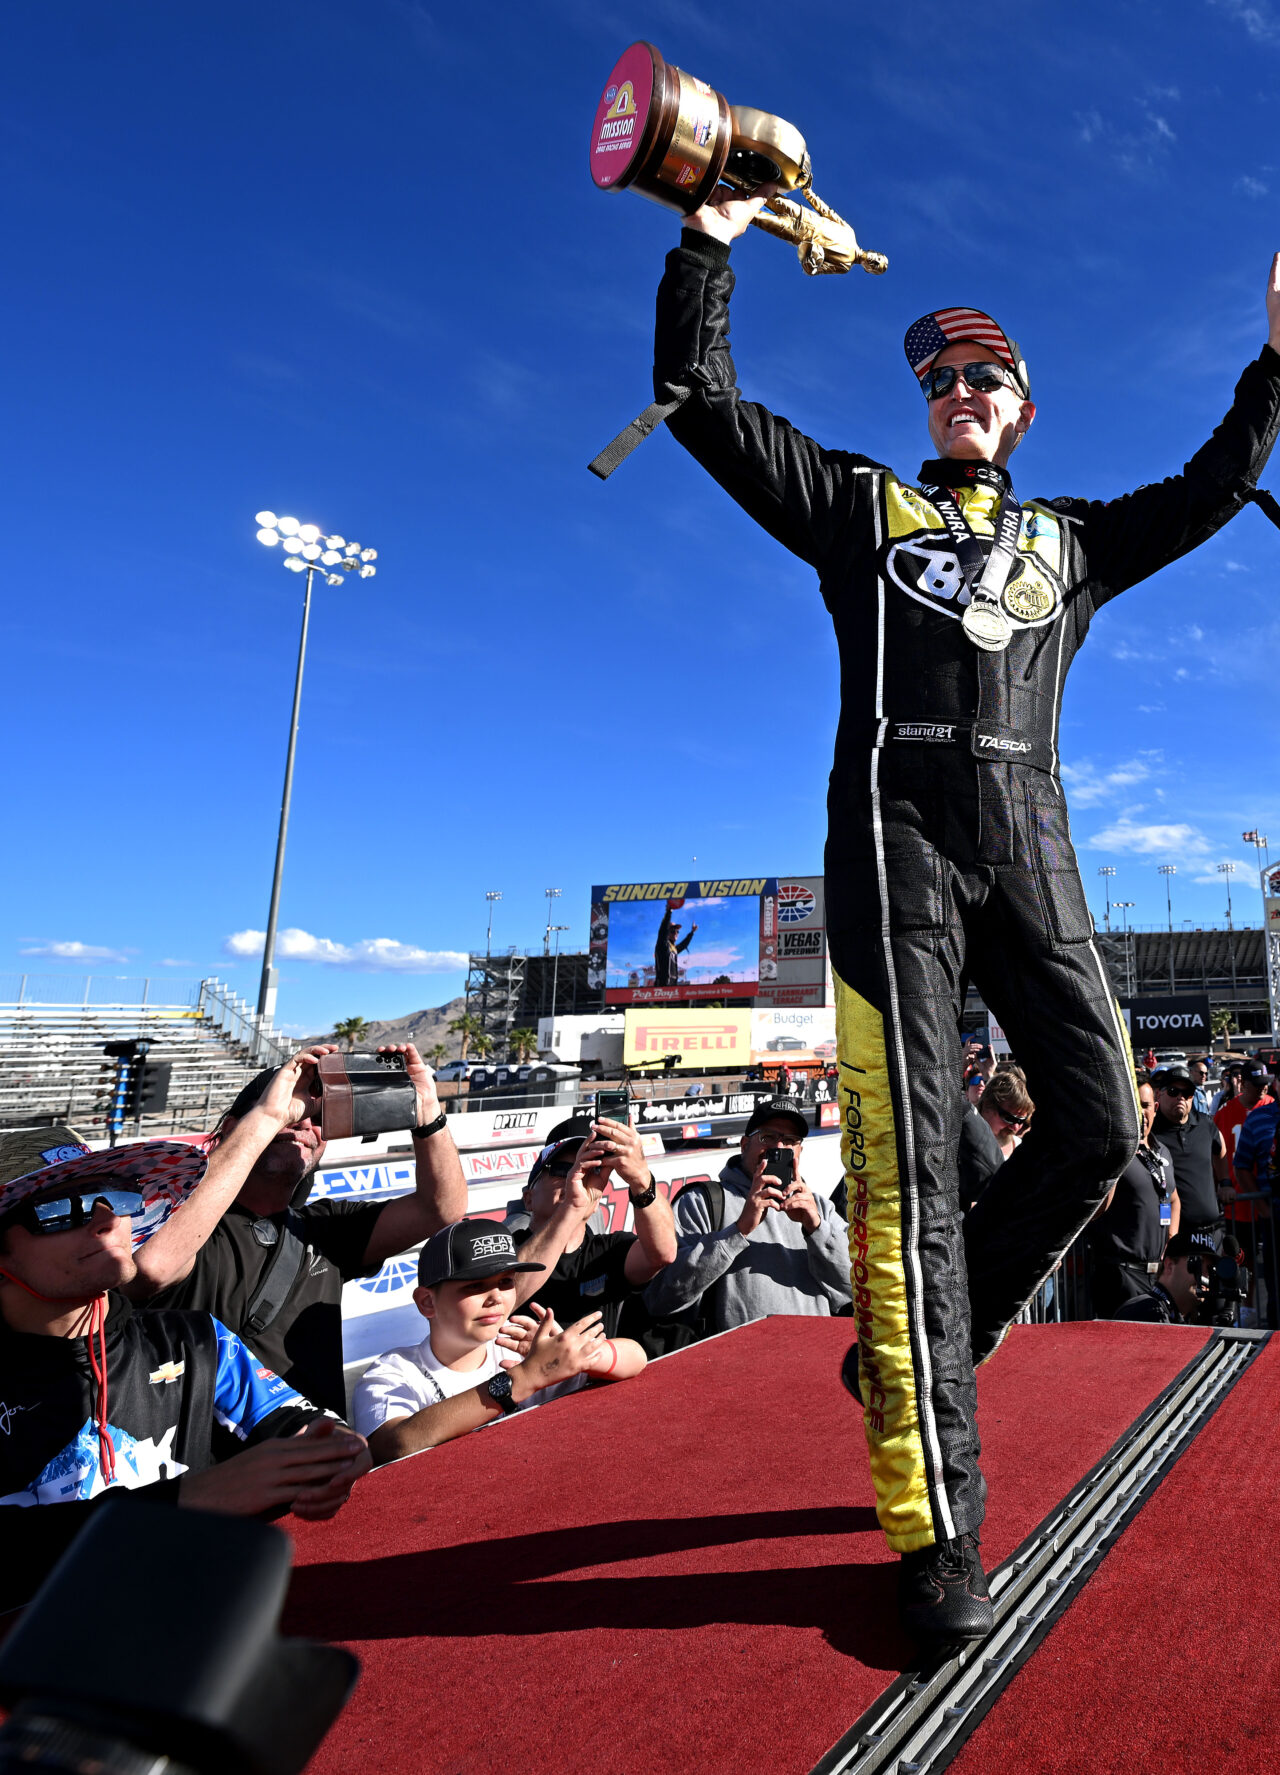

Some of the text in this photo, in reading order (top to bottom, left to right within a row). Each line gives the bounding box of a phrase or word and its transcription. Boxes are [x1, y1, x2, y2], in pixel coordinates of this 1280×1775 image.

[601, 117, 634, 140] MISSION
[936, 500, 970, 544] NHRA
[998, 510, 1020, 552] NHRA
[978, 735, 1026, 753] TASCA
[603, 879, 767, 901] SUNOCO VISION
[783, 932, 821, 948] VEGAS
[783, 946, 821, 956] SPEEDWAY
[774, 1013, 814, 1027] Budget
[1136, 1014, 1204, 1030] TOYOTA
[635, 1025, 738, 1052] PIRELLI
[493, 1112, 538, 1131] OPTIMA
[843, 1087, 868, 1172] FORD
[472, 1151, 539, 1172] NATI
[312, 1164, 416, 1196] 4-WID
[472, 1236, 509, 1250] AQUA
[473, 1244, 509, 1257] PROP
[852, 1175, 885, 1434] PERFORMANCE
